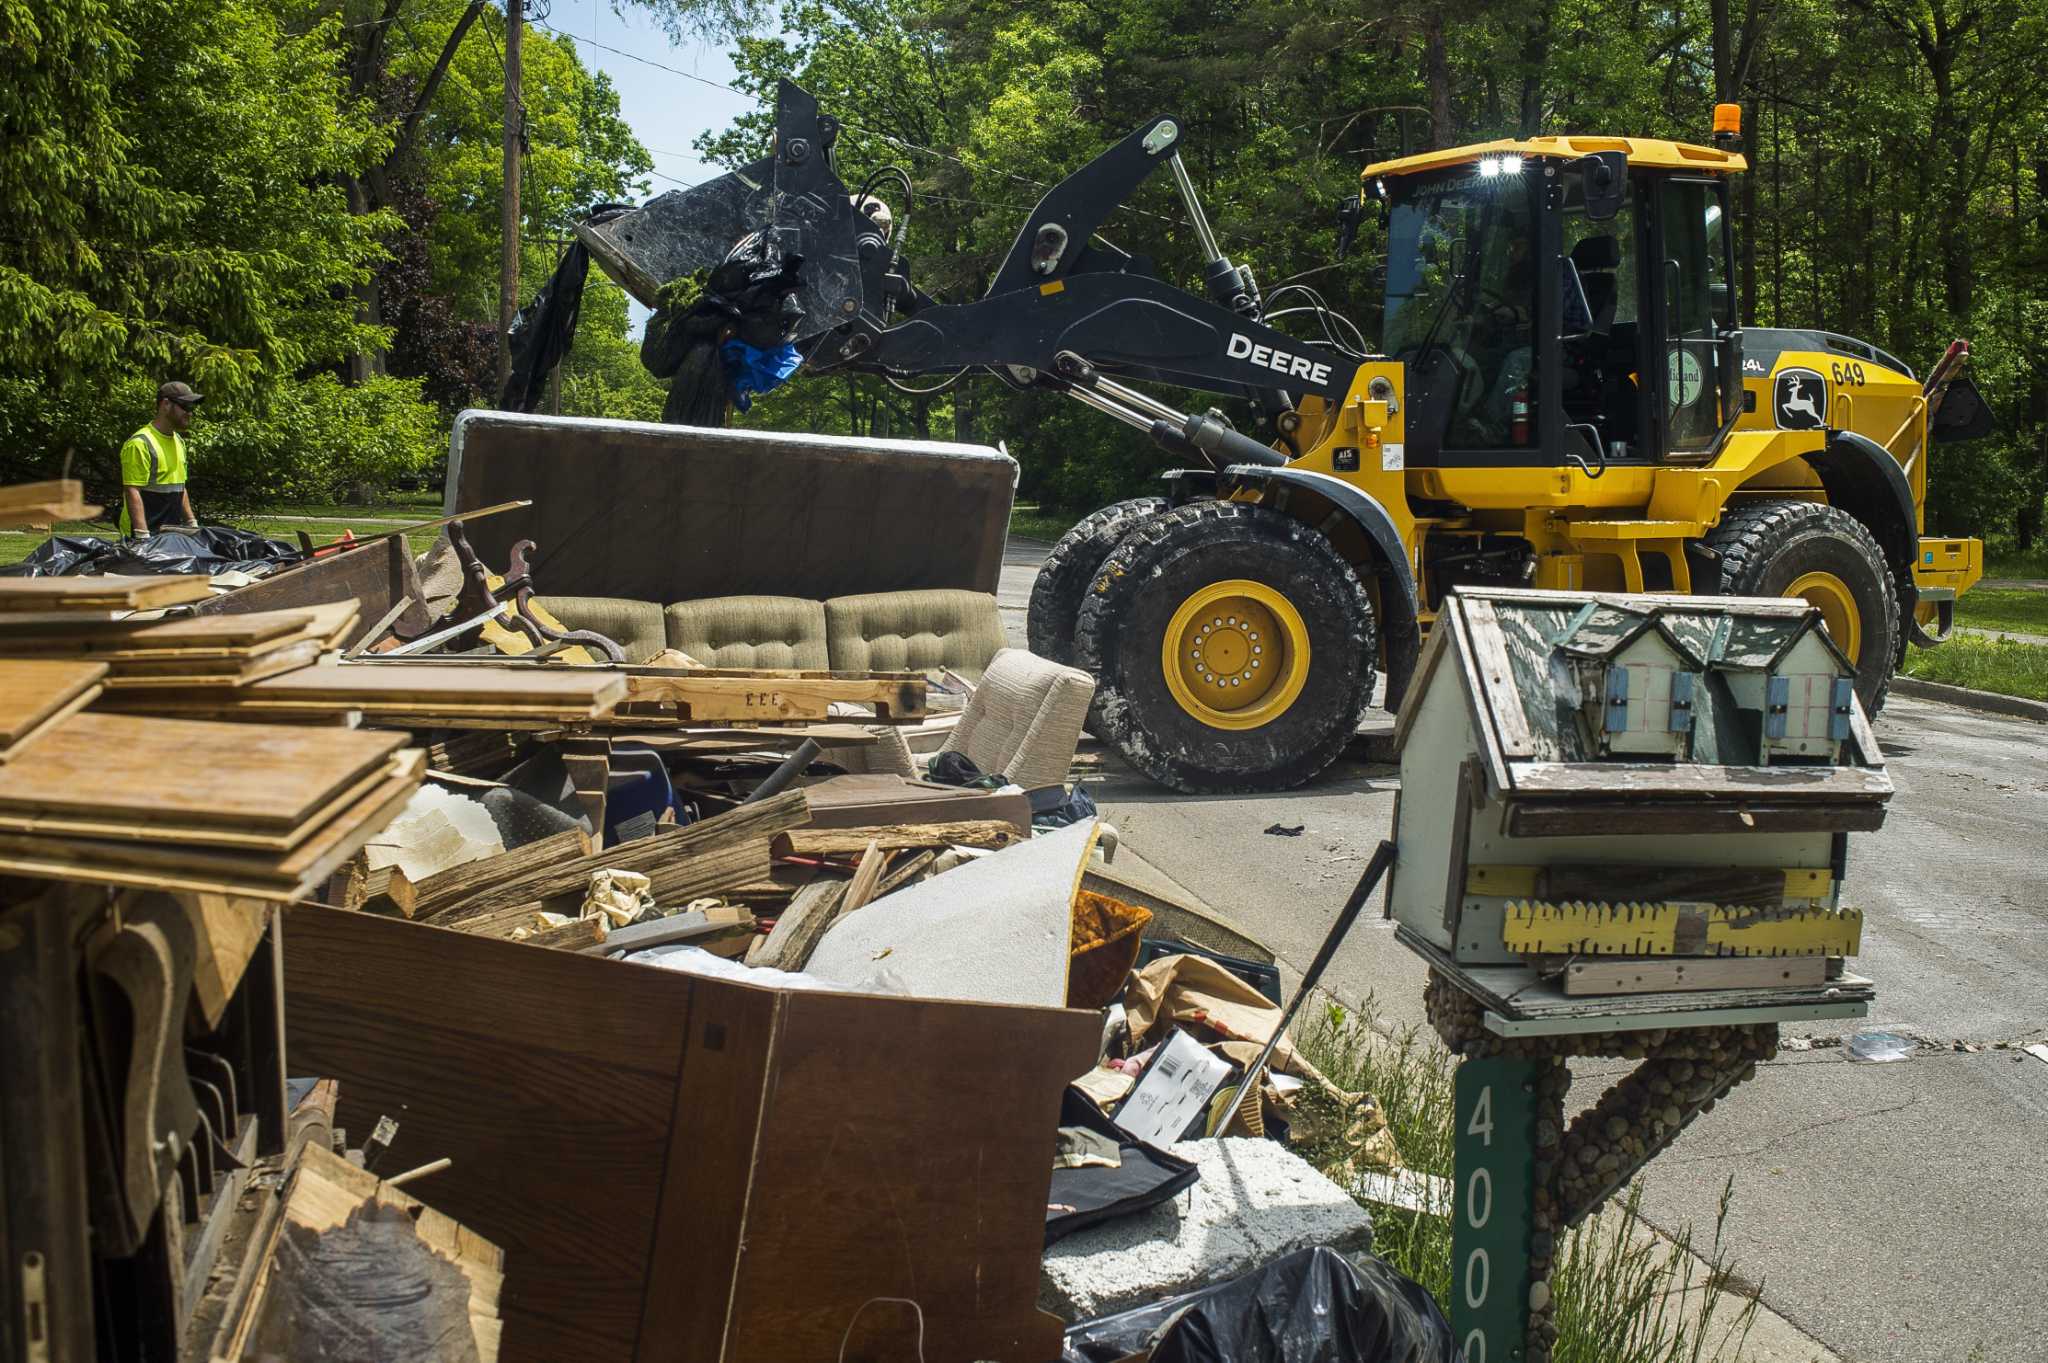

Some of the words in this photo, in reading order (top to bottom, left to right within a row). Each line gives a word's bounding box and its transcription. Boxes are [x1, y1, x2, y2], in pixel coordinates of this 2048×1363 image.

[1412, 183, 1444, 197] JOHN
[1226, 332, 1333, 386] DEERE
[1668, 368, 1699, 381] Midand
[1832, 362, 1865, 386] 649
